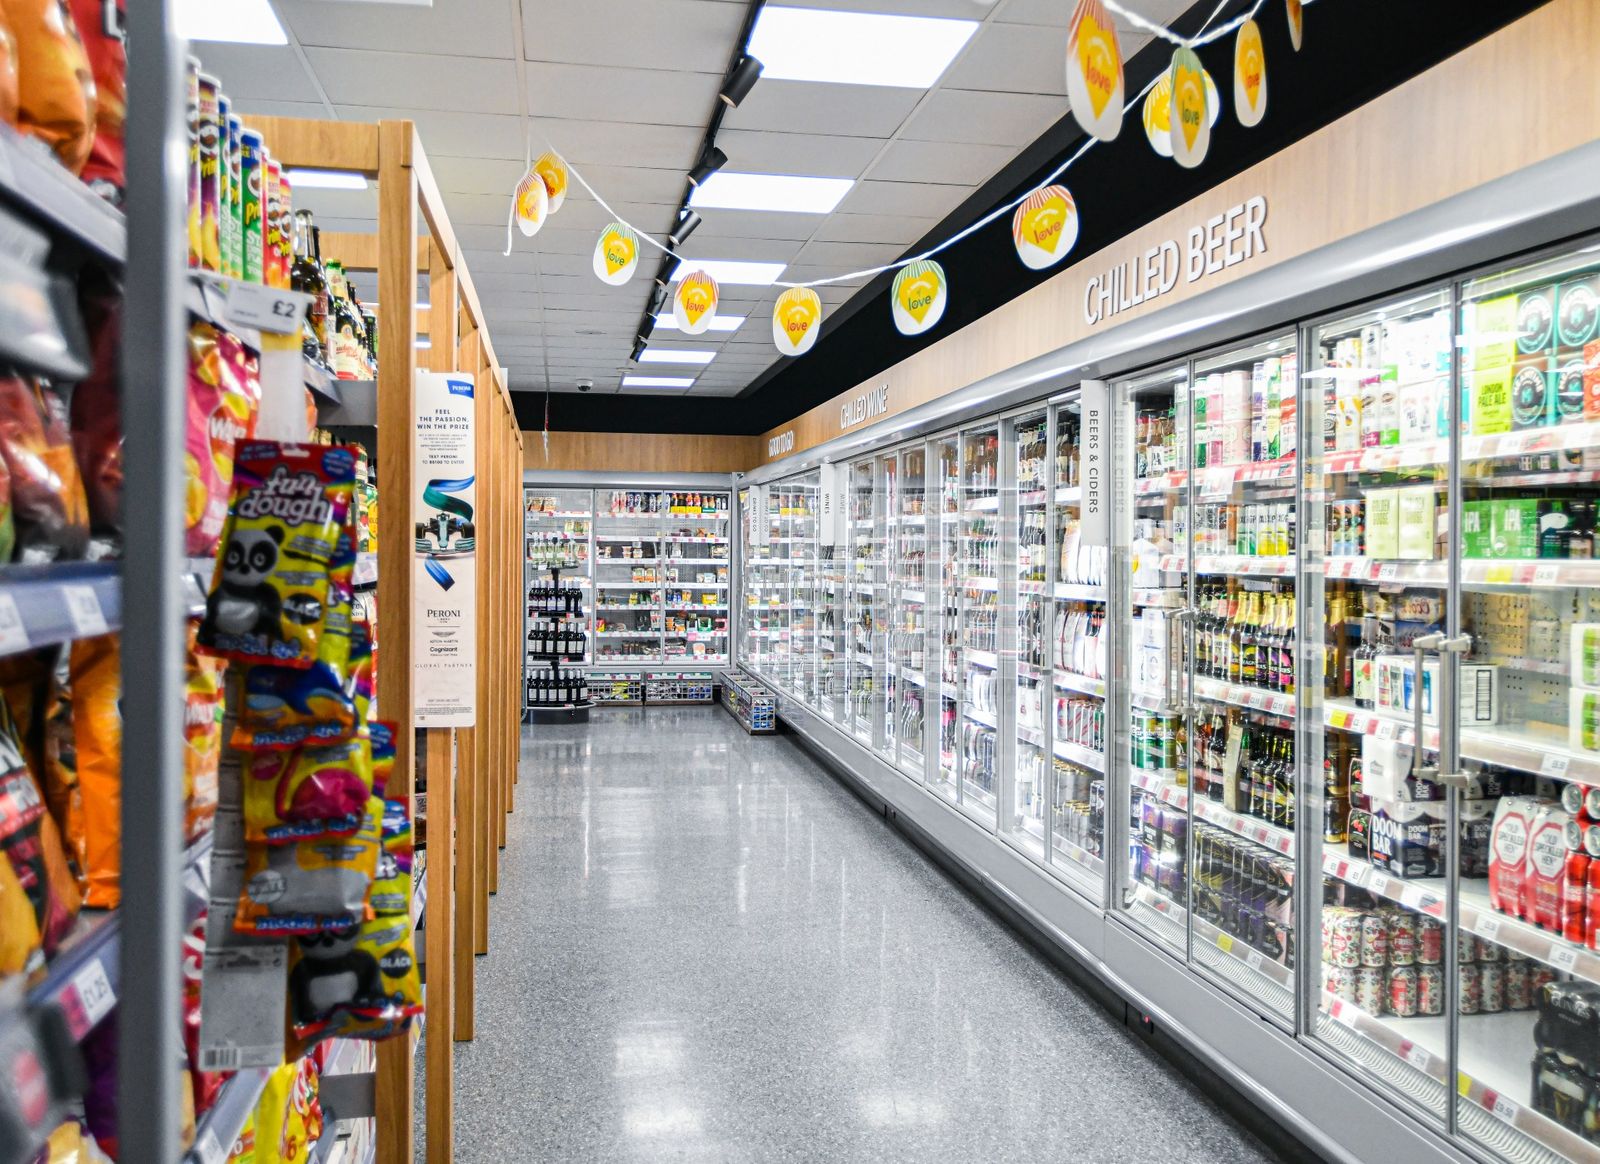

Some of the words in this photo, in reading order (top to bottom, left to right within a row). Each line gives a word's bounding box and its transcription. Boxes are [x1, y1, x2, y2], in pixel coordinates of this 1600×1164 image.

[1086, 54, 1111, 93] love
[1246, 70, 1259, 88] love
[1182, 99, 1199, 126] love
[1033, 220, 1061, 243] love
[607, 251, 625, 266] love
[1083, 239, 1180, 325] CHILLED
[1187, 195, 1267, 283] BEER
[272, 300, 296, 318] £2
[686, 297, 705, 313] love
[908, 293, 931, 311] love
[787, 319, 808, 333] love
[841, 395, 866, 430] CHILLED
[866, 384, 888, 419] WINE
[1478, 394, 1493, 408] PALE
[1494, 392, 1507, 405] ALE
[1089, 410, 1098, 449] BEERS
[1089, 454, 1098, 463] &
[265, 467, 315, 496] fun
[1089, 467, 1098, 514] CIDERS
[239, 487, 329, 525] dough
[1465, 511, 1480, 533] IPA
[1504, 508, 1521, 531] IPA
[427, 609, 461, 618] PERONI
[1372, 815, 1402, 841] DOOM
[1408, 825, 1428, 834] DOOM
[1408, 832, 1421, 841] BAR
[1373, 832, 1392, 857] BAR
[380, 957, 411, 969] BLACK
